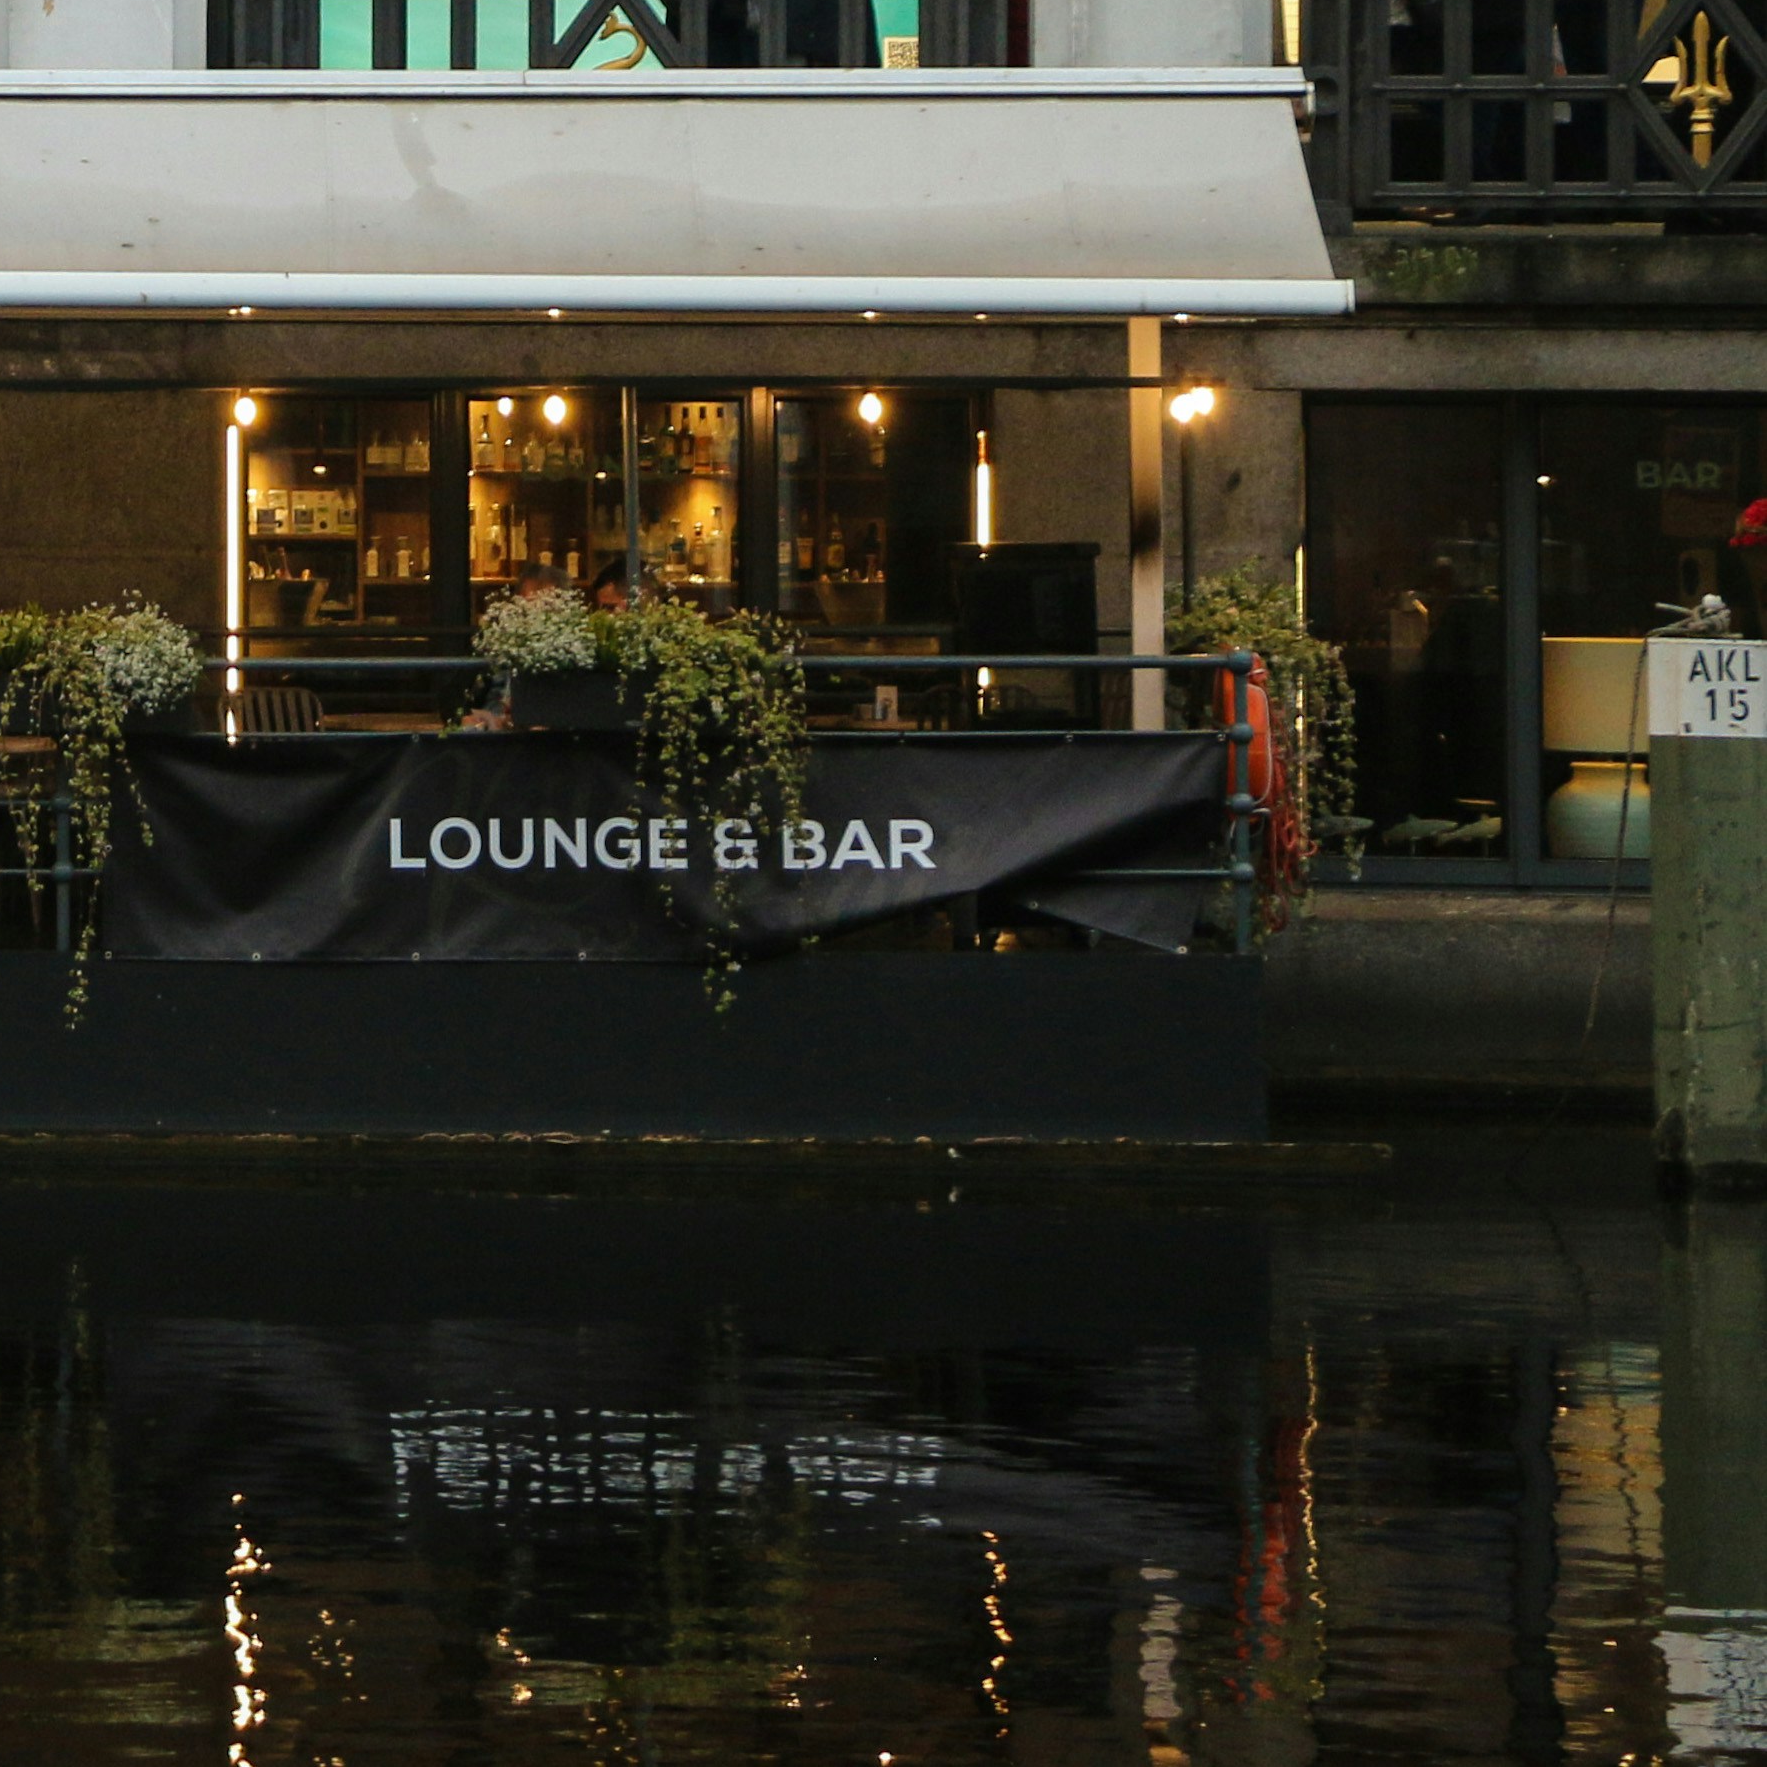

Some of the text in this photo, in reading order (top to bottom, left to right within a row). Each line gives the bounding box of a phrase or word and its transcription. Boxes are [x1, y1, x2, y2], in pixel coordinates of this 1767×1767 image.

[1636, 459, 1722, 489] BAR
[1689, 648, 1762, 684] AKL
[1703, 687, 1751, 722] 15
[389, 815, 937, 871] LOUNGE & BAR
